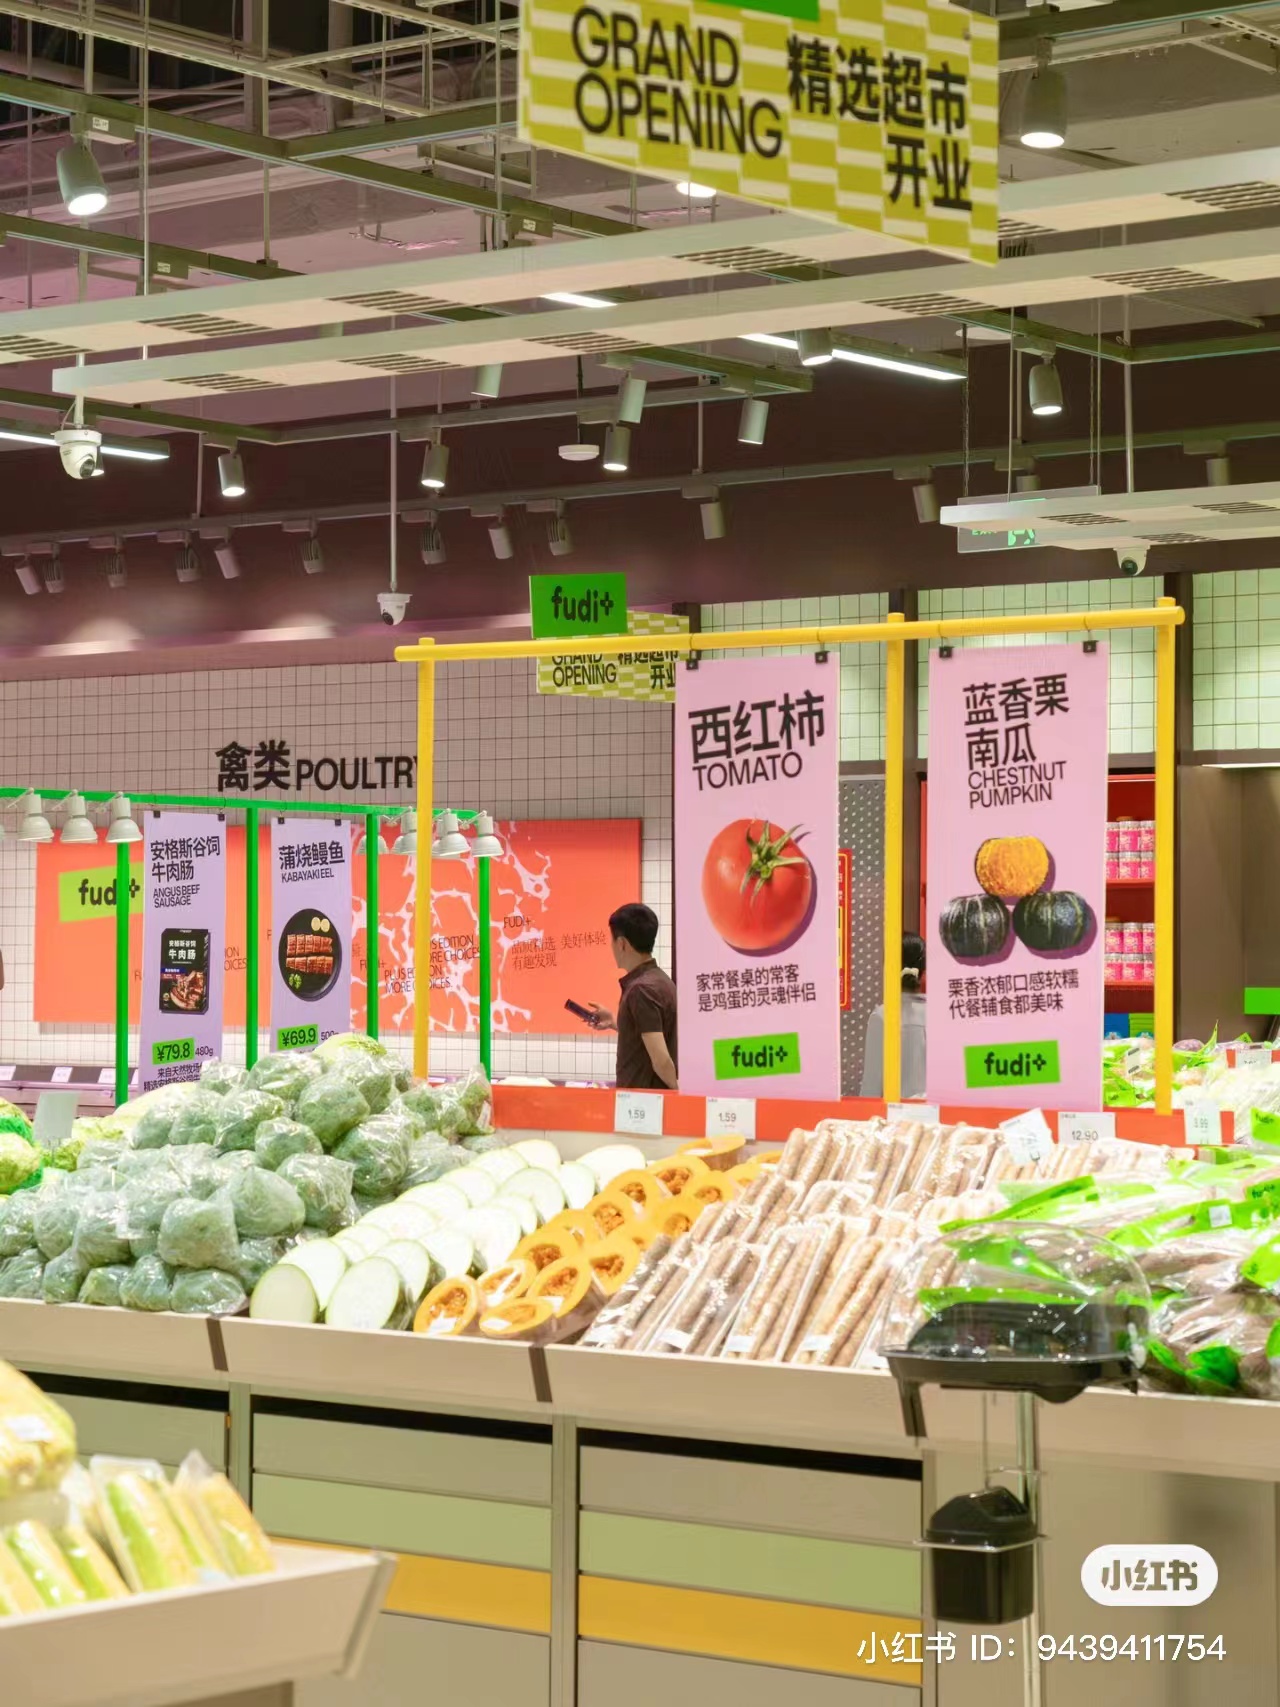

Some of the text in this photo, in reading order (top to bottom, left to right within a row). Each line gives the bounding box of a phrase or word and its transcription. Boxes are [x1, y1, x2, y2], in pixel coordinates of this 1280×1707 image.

[572, 6, 739, 88] GRAND
[786, 34, 967, 134] 精选超市
[574, 73, 782, 158] OPENING
[886, 134, 973, 210] 开业
[552, 663, 617, 687] OPENING
[963, 673, 1070, 726] 蓝香栗
[688, 689, 824, 764] 西红柿
[965, 722, 1037, 770] 南瓜
[215, 739, 290, 792] 禽类
[296, 756, 417, 790] POULTR
[692, 751, 803, 791] TOMATO
[968, 761, 1067, 790] CHESTNUT
[969, 782, 1052, 809] PUMPKIN
[150, 835, 221, 861] 安格斯谷饲
[278, 841, 345, 870] 蒲烧鳗鱼
[152, 861, 194, 883] 牛肉肠
[78, 878, 140, 905] fud+
[154, 896, 191, 908] SAUSAGE
[168, 948, 196, 960] 牛肉肠
[696, 964, 800, 992] 家常餐桌的常客
[948, 968, 1080, 998] 栗香浓郁口感软糯
[698, 982, 817, 1012] 是鸡蛋的灵魂伴侣
[949, 991, 1064, 1019] 代餐辅食都美味
[157, 1042, 213, 1062] ¥79.8 480g
[282, 1028, 316, 1047] ¥69.9
